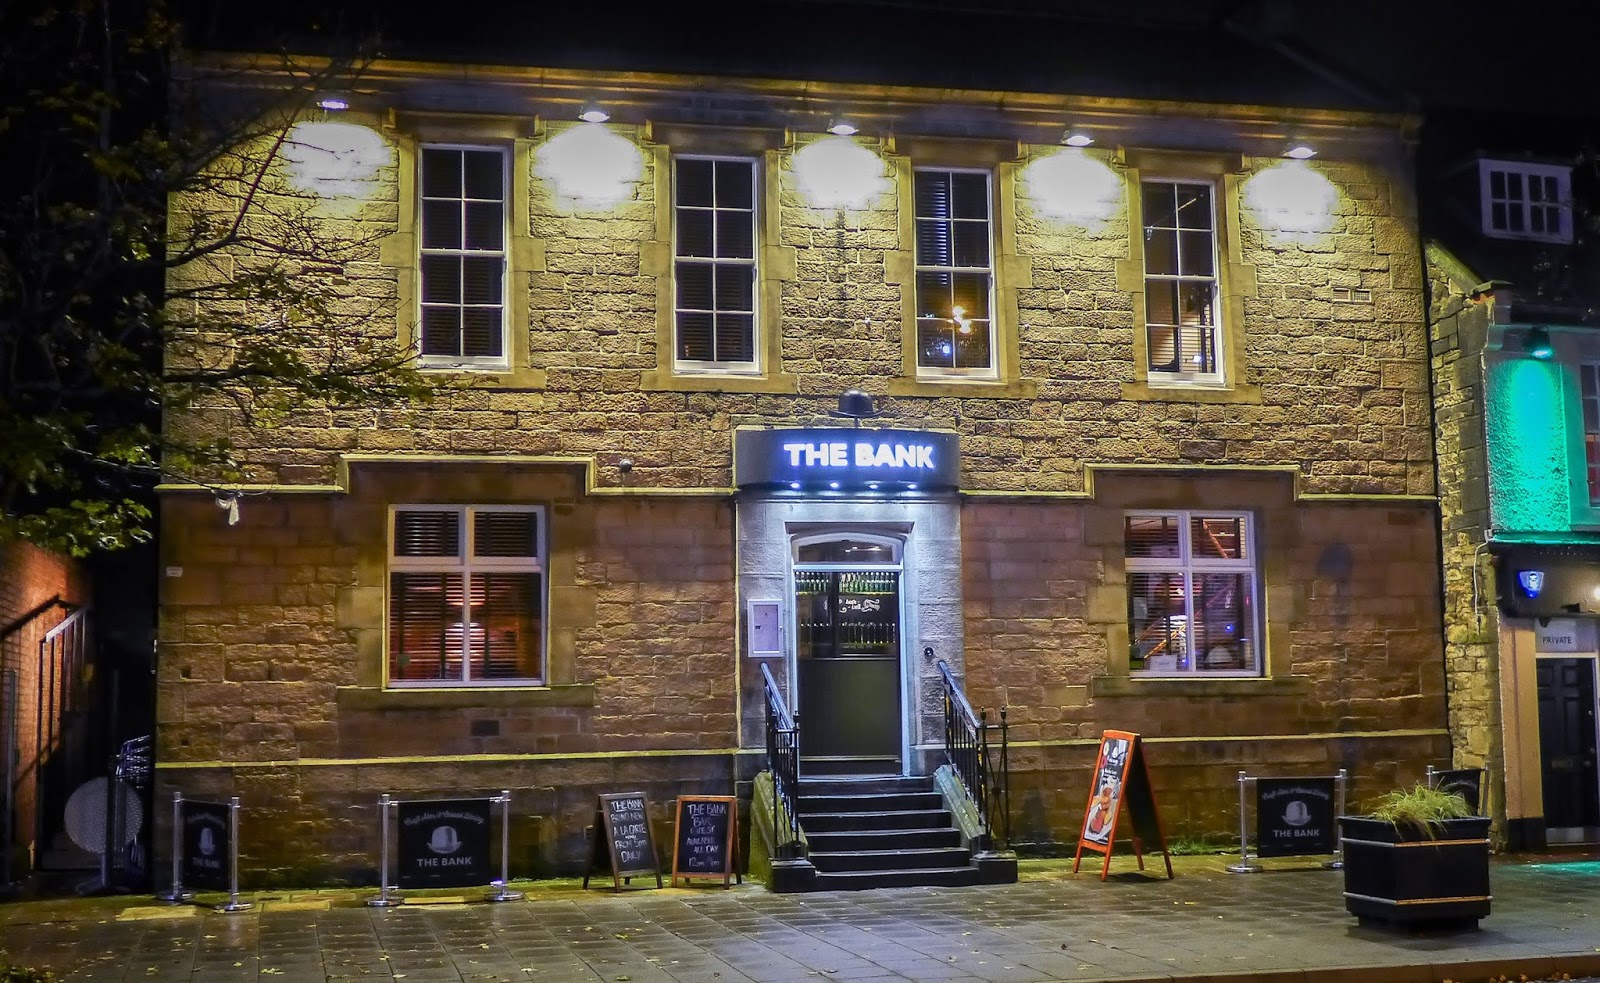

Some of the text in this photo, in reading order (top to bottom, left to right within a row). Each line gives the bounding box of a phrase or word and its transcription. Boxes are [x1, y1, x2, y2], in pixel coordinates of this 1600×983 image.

[783, 443, 935, 468] THE BANK
[1542, 636, 1572, 644] PRIVATE
[611, 799, 644, 811] THE BANK
[687, 804, 726, 814] THE BANK
[620, 825, 629, 836] LA
[629, 822, 647, 834] CARTE
[1273, 828, 1320, 837] THE BANK
[615, 840, 632, 849] FROM
[417, 856, 472, 867] THE BANK
